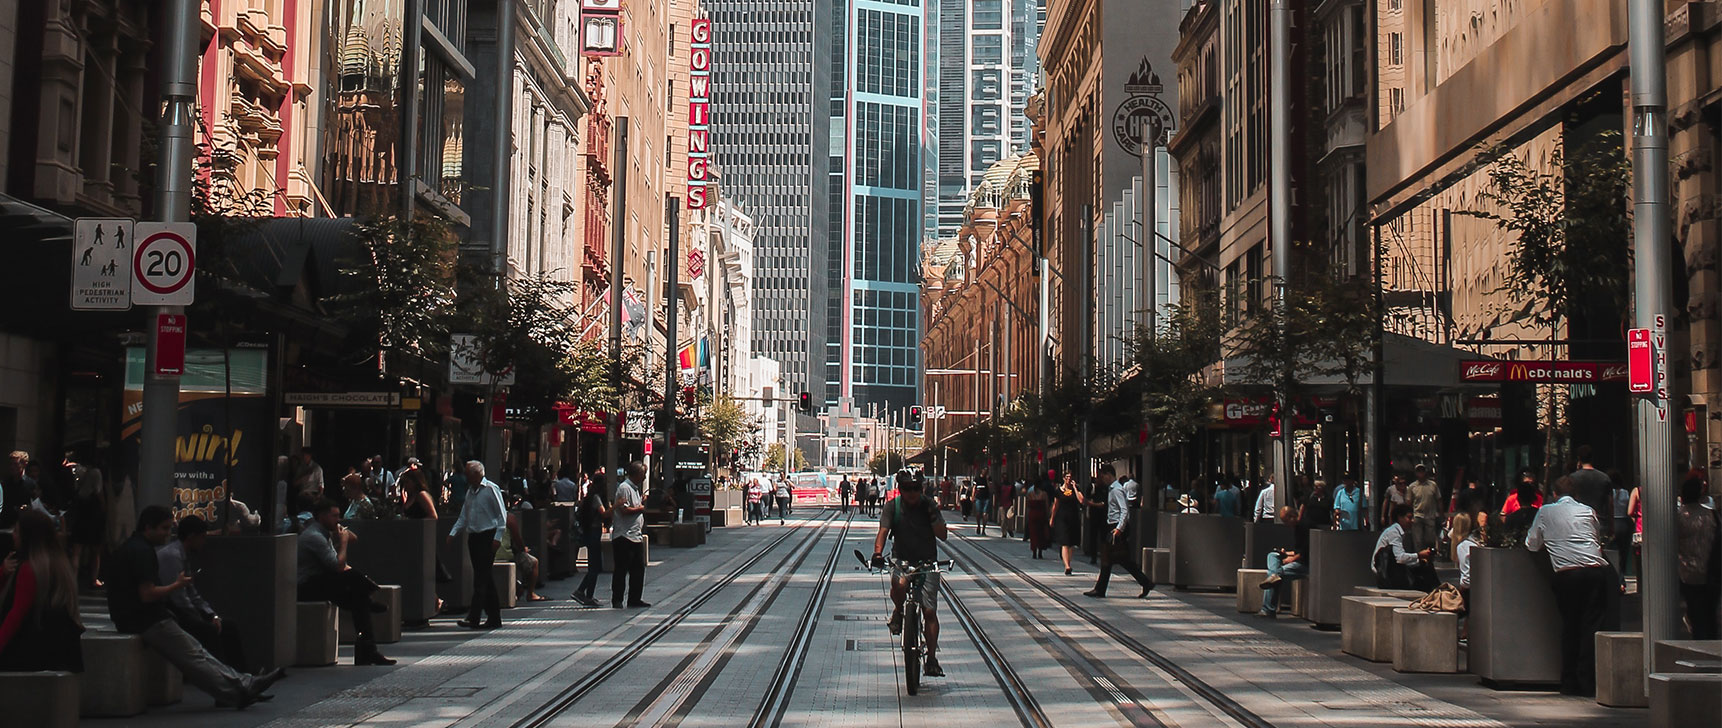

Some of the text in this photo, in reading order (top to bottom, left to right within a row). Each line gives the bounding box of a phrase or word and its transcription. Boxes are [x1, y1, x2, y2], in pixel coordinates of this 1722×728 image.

[1123, 98, 1164, 113] HEALTH
[688, 21, 708, 208] GOWINGS
[1116, 126, 1137, 152] CARE
[146, 250, 182, 277] 20
[1630, 340, 1648, 349] STOPPING
[1510, 363, 1592, 380] McDonald's
[128, 400, 144, 415] NE
[188, 470, 208, 479] with
[172, 479, 228, 505] ramel
